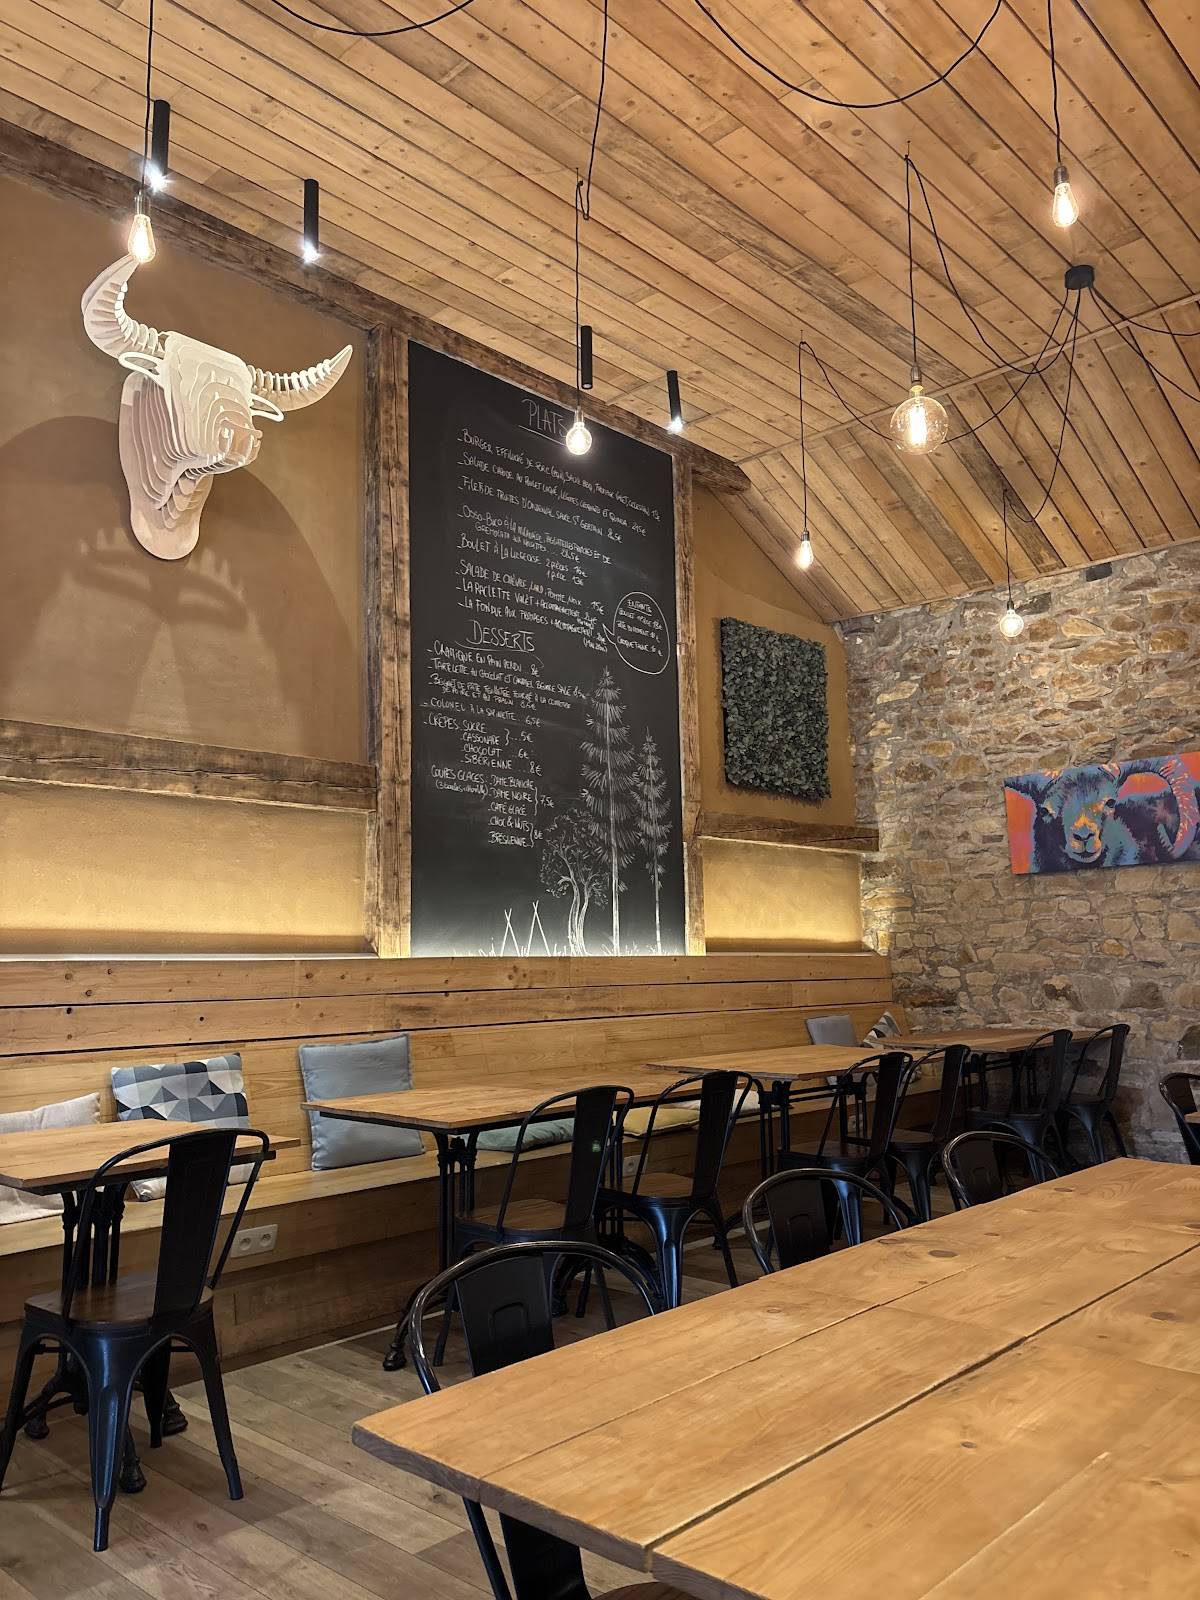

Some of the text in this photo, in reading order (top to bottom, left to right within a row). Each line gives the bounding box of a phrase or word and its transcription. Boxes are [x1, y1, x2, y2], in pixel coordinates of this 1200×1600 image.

[521, 399, 567, 438] PLATS
[462, 428, 493, 454] BURGER
[463, 451, 490, 473] SALADE
[461, 533, 491, 553] BOULET
[500, 544, 509, 560] LA
[460, 559, 489, 580] SALADE
[492, 570, 501, 582] DE
[463, 577, 473, 593] LA
[474, 582, 511, 601] RACLETTE
[465, 596, 473, 609] LA
[475, 599, 503, 617] FONDUE
[465, 619, 535, 652] DESSERTS
[434, 639, 473, 663] CRAMIQUE
[475, 652, 486, 664] EN
[487, 654, 502, 668] PAIN
[504, 673, 513, 684] ET
[430, 697, 466, 712] COLONEL
[476, 705, 484, 715] LA
[462, 719, 487, 734] SUCRE
[462, 730, 534, 746] CASSONADE 5€
[463, 743, 503, 758] CHOCOLAT
[431, 764, 456, 780] COUPES
[529, 760, 542, 776] 8€
[490, 787, 510, 801] DAME
[490, 801, 508, 815] CAFÉ
[514, 820, 530, 832] NUTS
[534, 829, 544, 840] 8€
